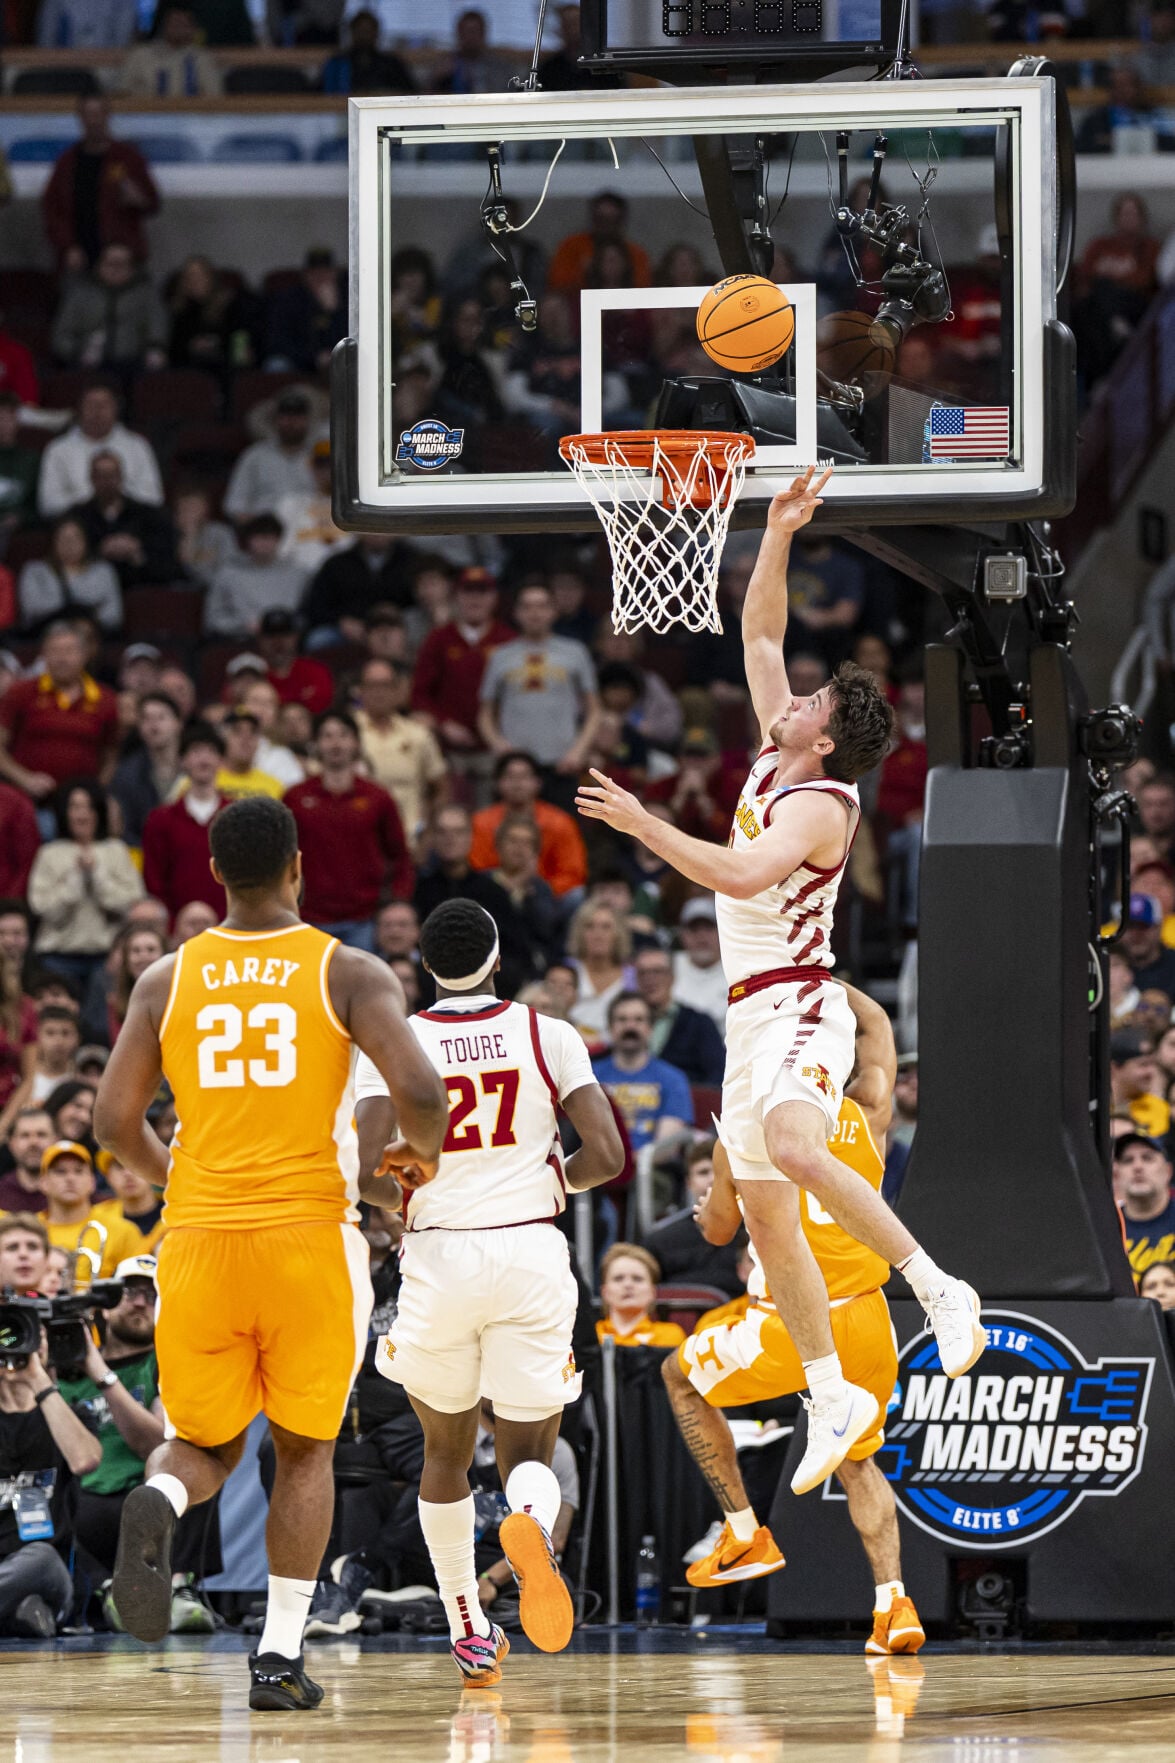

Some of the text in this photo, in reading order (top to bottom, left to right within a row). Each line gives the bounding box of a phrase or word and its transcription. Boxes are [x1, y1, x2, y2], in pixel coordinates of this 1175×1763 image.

[412, 433, 446, 444] MARCH
[416, 443, 461, 454] MADNESS
[201, 956, 301, 990] CAREY
[196, 1002, 297, 1089] 23
[440, 1033, 507, 1064] TOURE
[440, 1067, 521, 1155] 27
[1005, 1330, 1029, 1352] 16
[901, 1374, 1065, 1422] MARCH
[919, 1424, 1138, 1472] MADNESS
[952, 1506, 1020, 1530] ELITE 8
